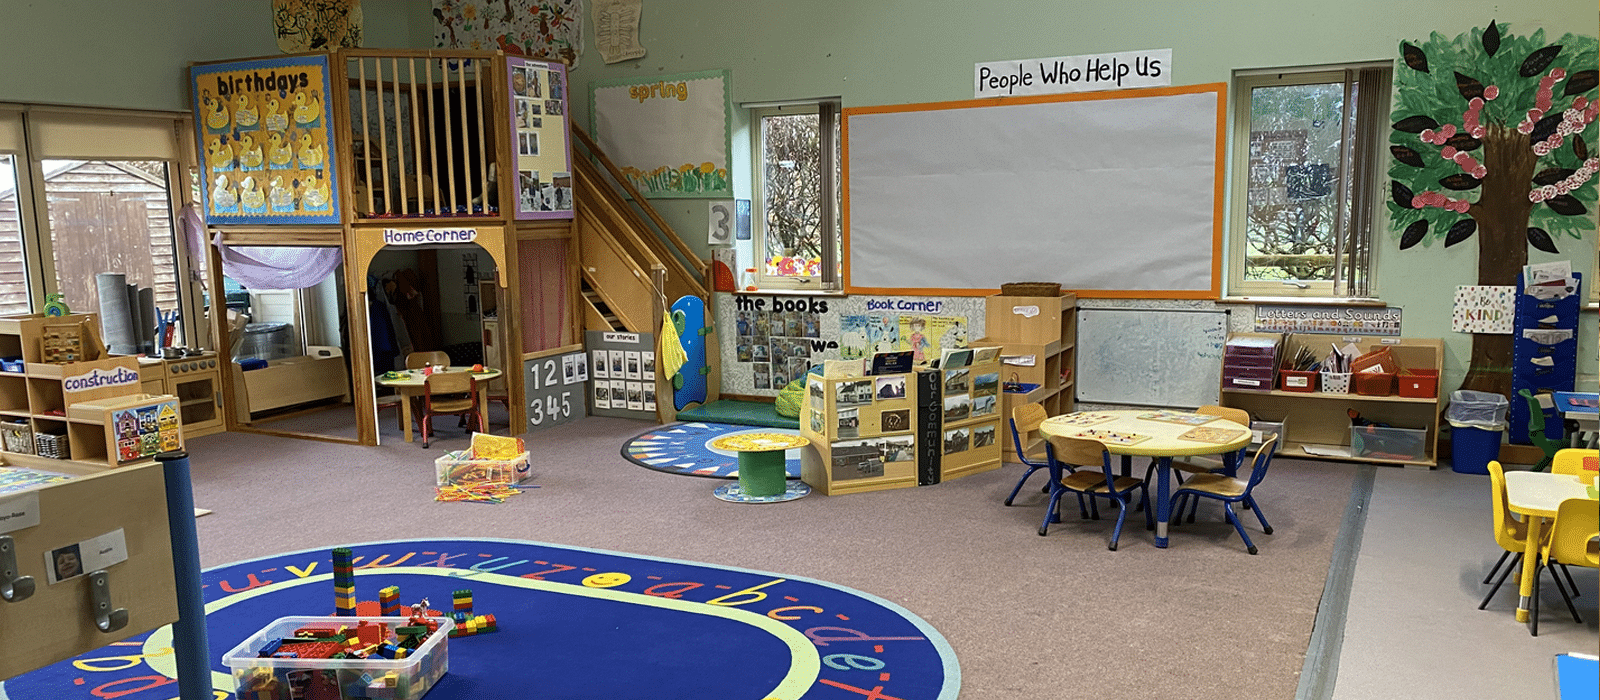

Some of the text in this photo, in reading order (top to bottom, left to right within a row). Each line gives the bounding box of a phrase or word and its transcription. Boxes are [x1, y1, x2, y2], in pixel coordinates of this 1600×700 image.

[217, 71, 309, 96] birthdays
[980, 56, 1161, 95] People Who Help Us
[629, 80, 688, 103] spring
[711, 204, 730, 241] 3
[384, 229, 476, 243] Home Corner
[735, 295, 829, 314] the books
[867, 298, 943, 312] Book Corner
[1257, 306, 1400, 321] Letters and Sounds
[1465, 309, 1504, 321] KIND
[65, 368, 138, 390] construction
